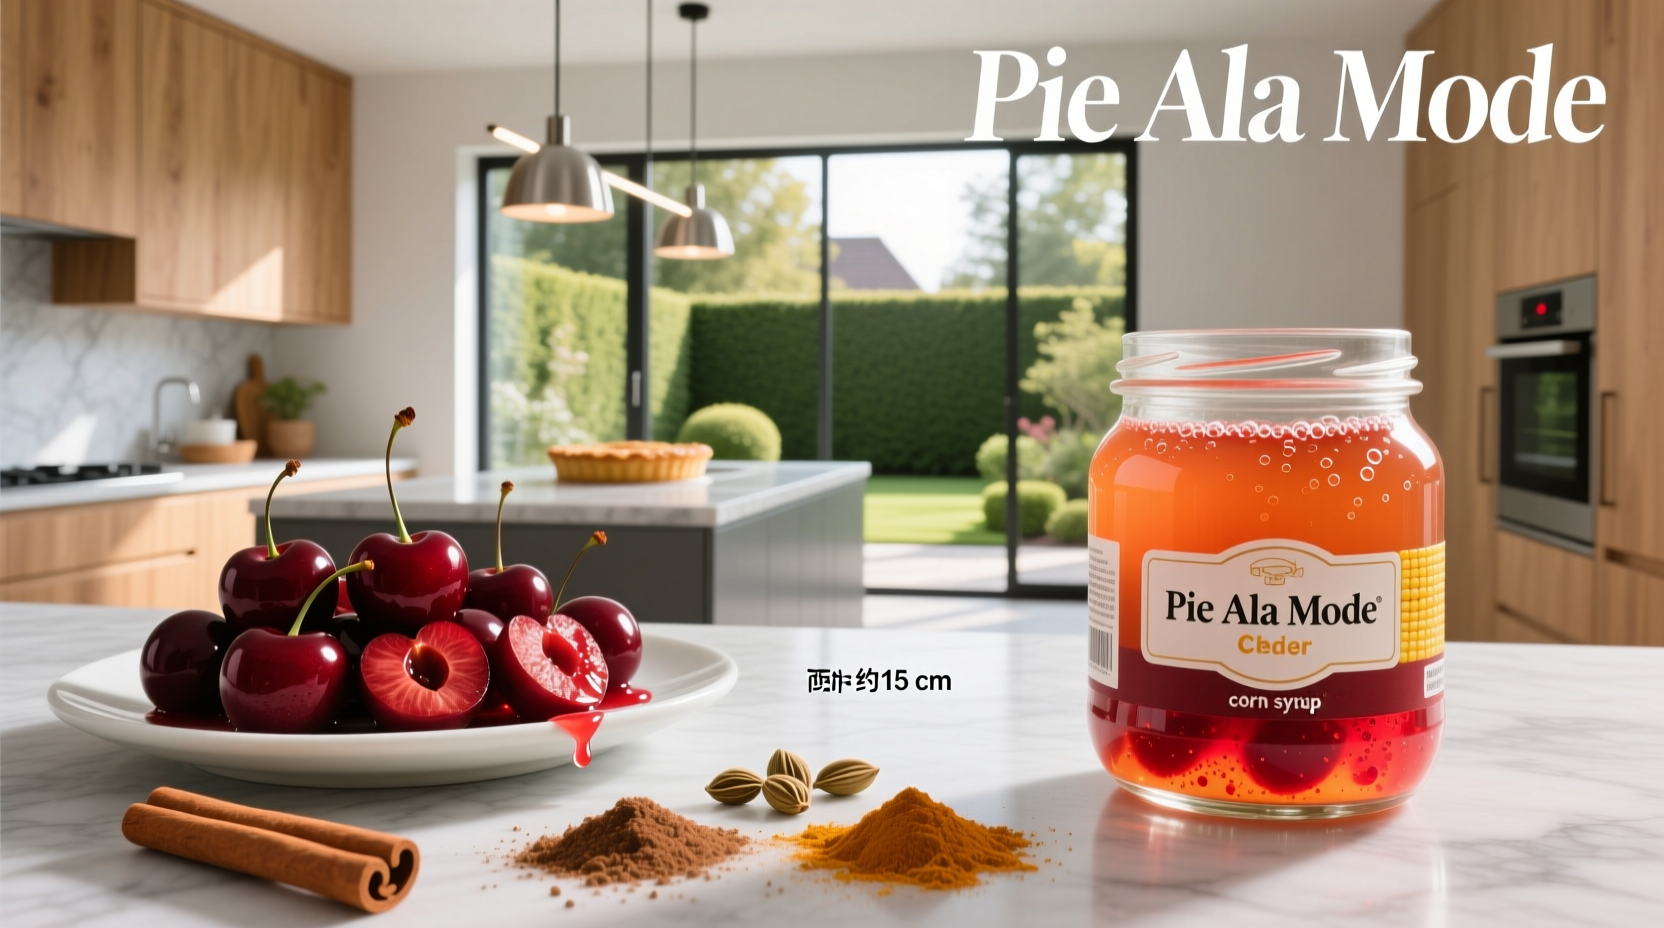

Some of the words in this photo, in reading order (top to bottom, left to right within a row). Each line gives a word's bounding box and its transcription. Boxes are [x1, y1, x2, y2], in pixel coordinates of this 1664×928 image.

[1165, 590, 1214, 624] Pie
[1221, 593, 1280, 626] Ala
[1228, 695, 1269, 709] corn
